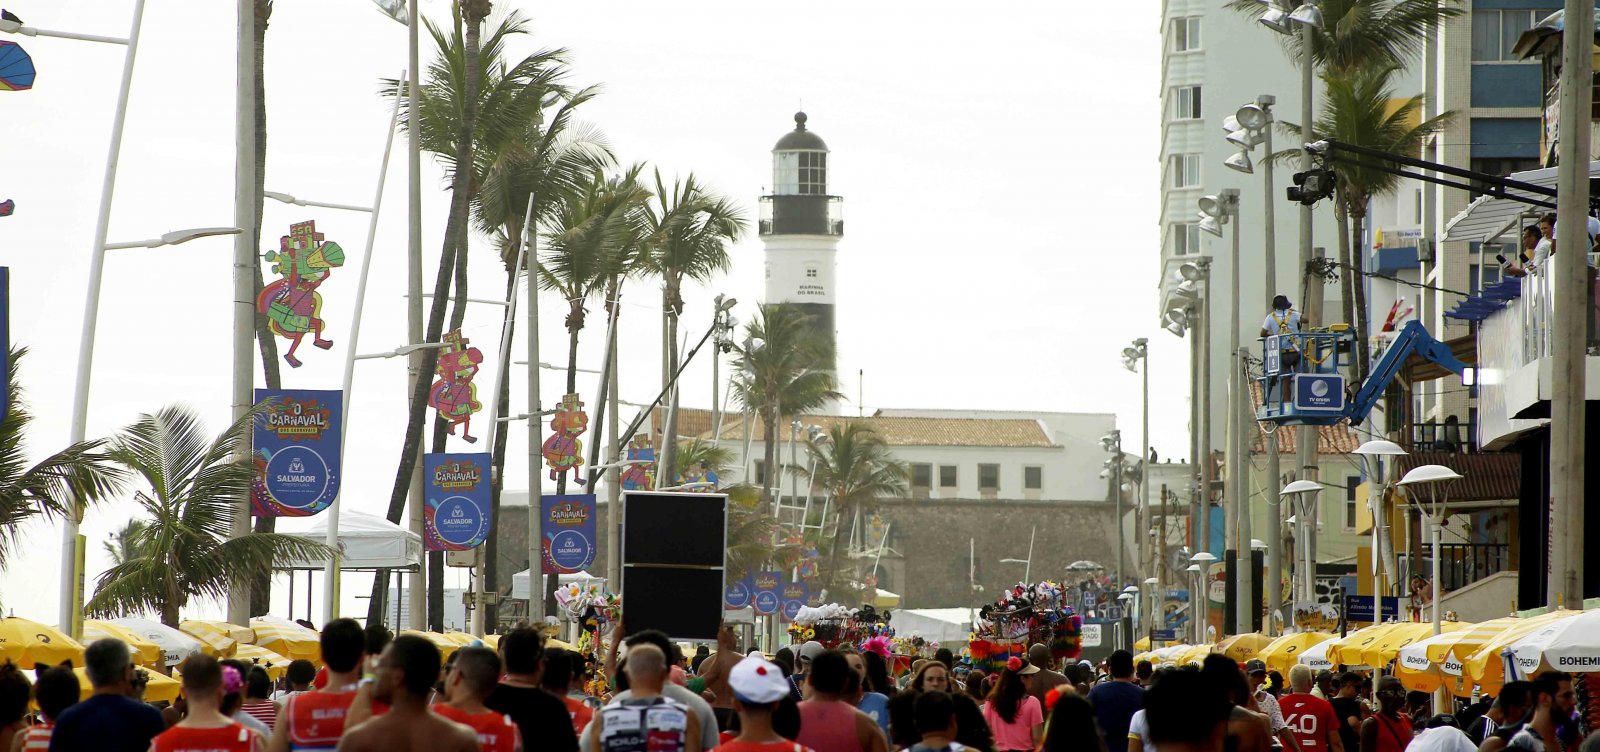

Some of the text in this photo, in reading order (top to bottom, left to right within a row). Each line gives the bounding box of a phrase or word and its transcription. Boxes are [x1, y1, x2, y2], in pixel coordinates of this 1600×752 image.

[294, 403, 301, 415] O
[270, 412, 325, 427] CARNAVAL
[453, 463, 460, 473] O
[276, 474, 316, 483] SALVADOR
[436, 470, 477, 481] CARNAVAL
[552, 509, 586, 520] CARNAVAL
[1559, 656, 1600, 666] BOHEMI
